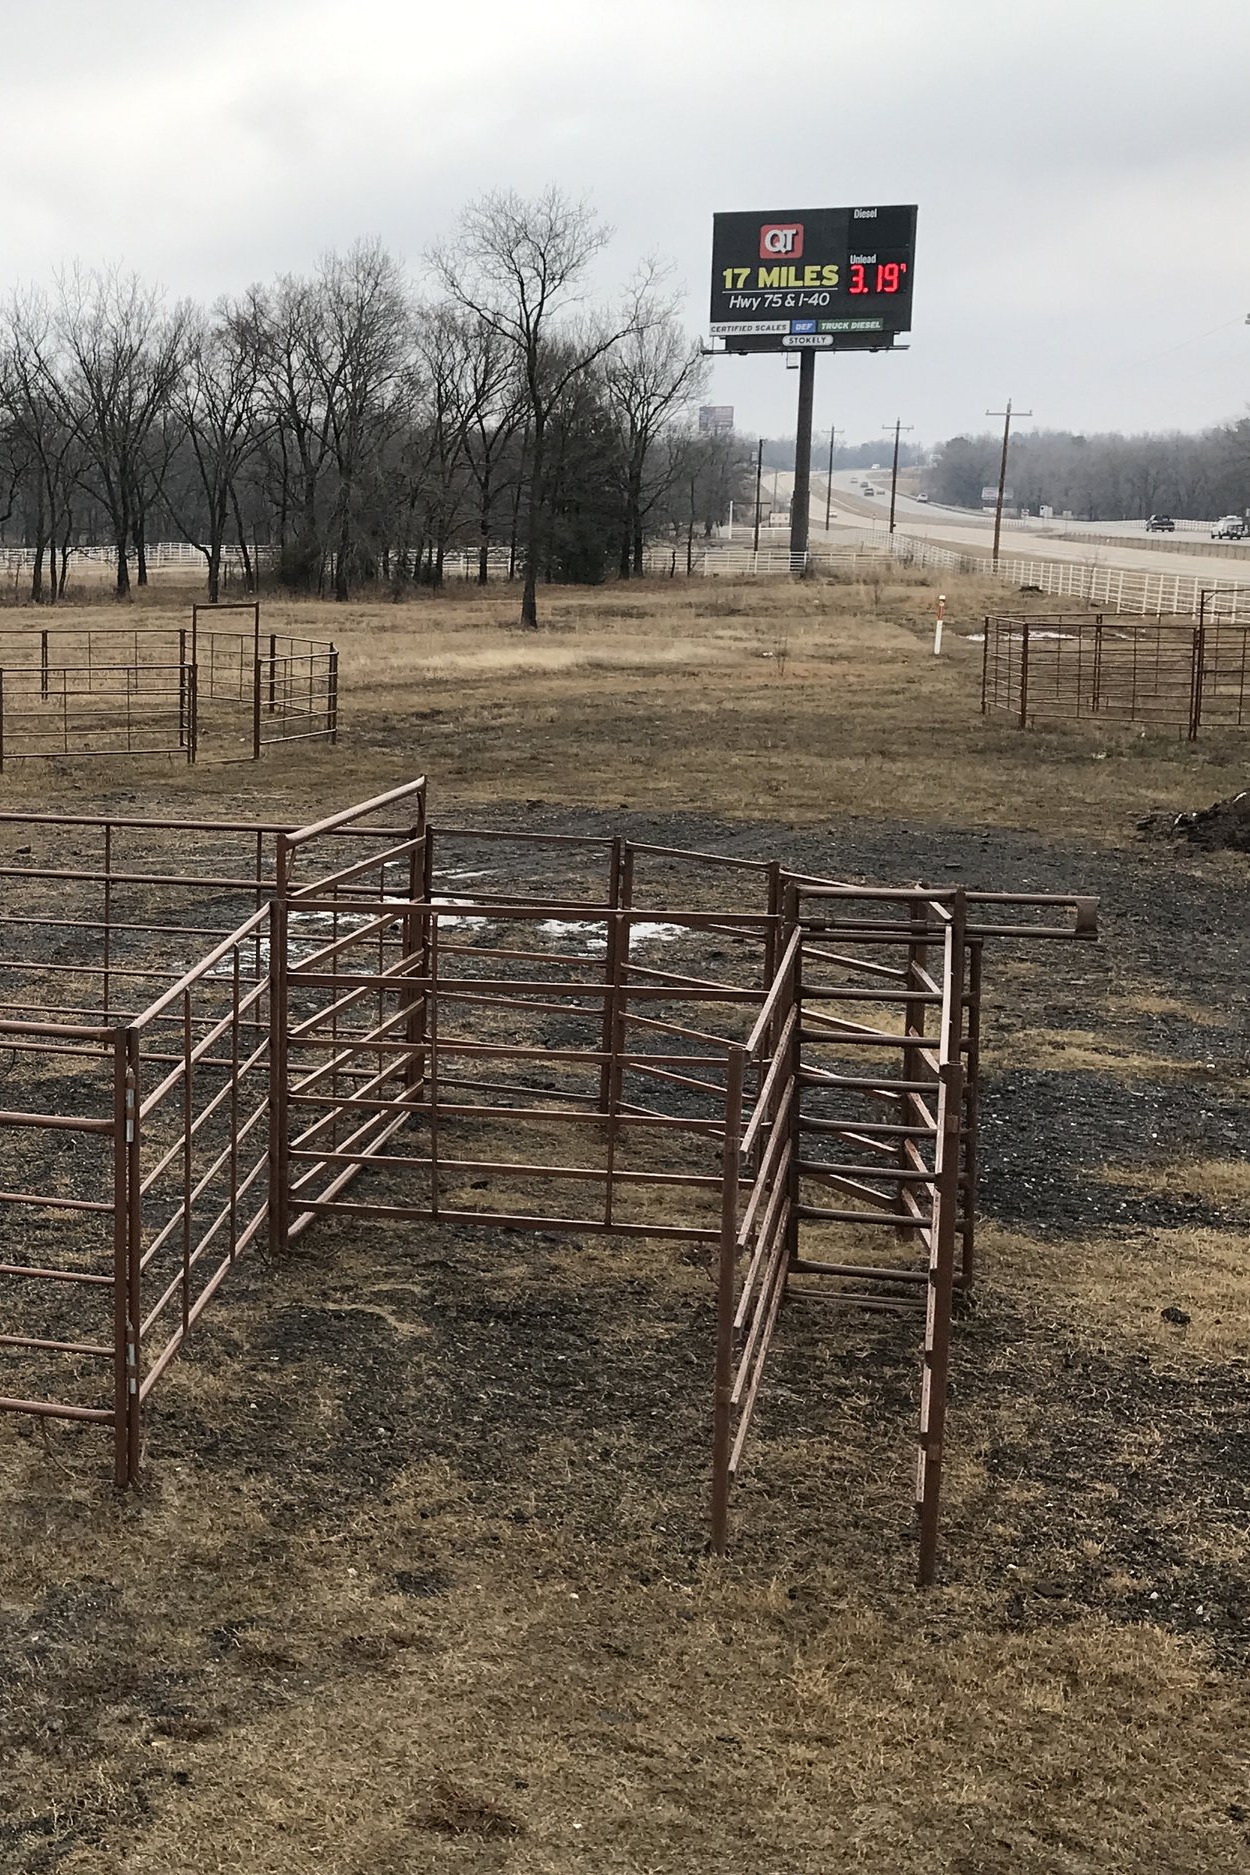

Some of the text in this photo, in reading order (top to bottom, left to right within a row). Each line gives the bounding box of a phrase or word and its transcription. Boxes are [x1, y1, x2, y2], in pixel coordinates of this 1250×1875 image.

[854, 208, 877, 218] Diesel
[765, 229, 796, 254] QT
[723, 265, 838, 289] 17 MILES
[729, 293, 829, 310] Hwy 75 & I-40
[711, 325, 752, 333] CERTIFIED
[851, 321, 880, 329] DIESEL
